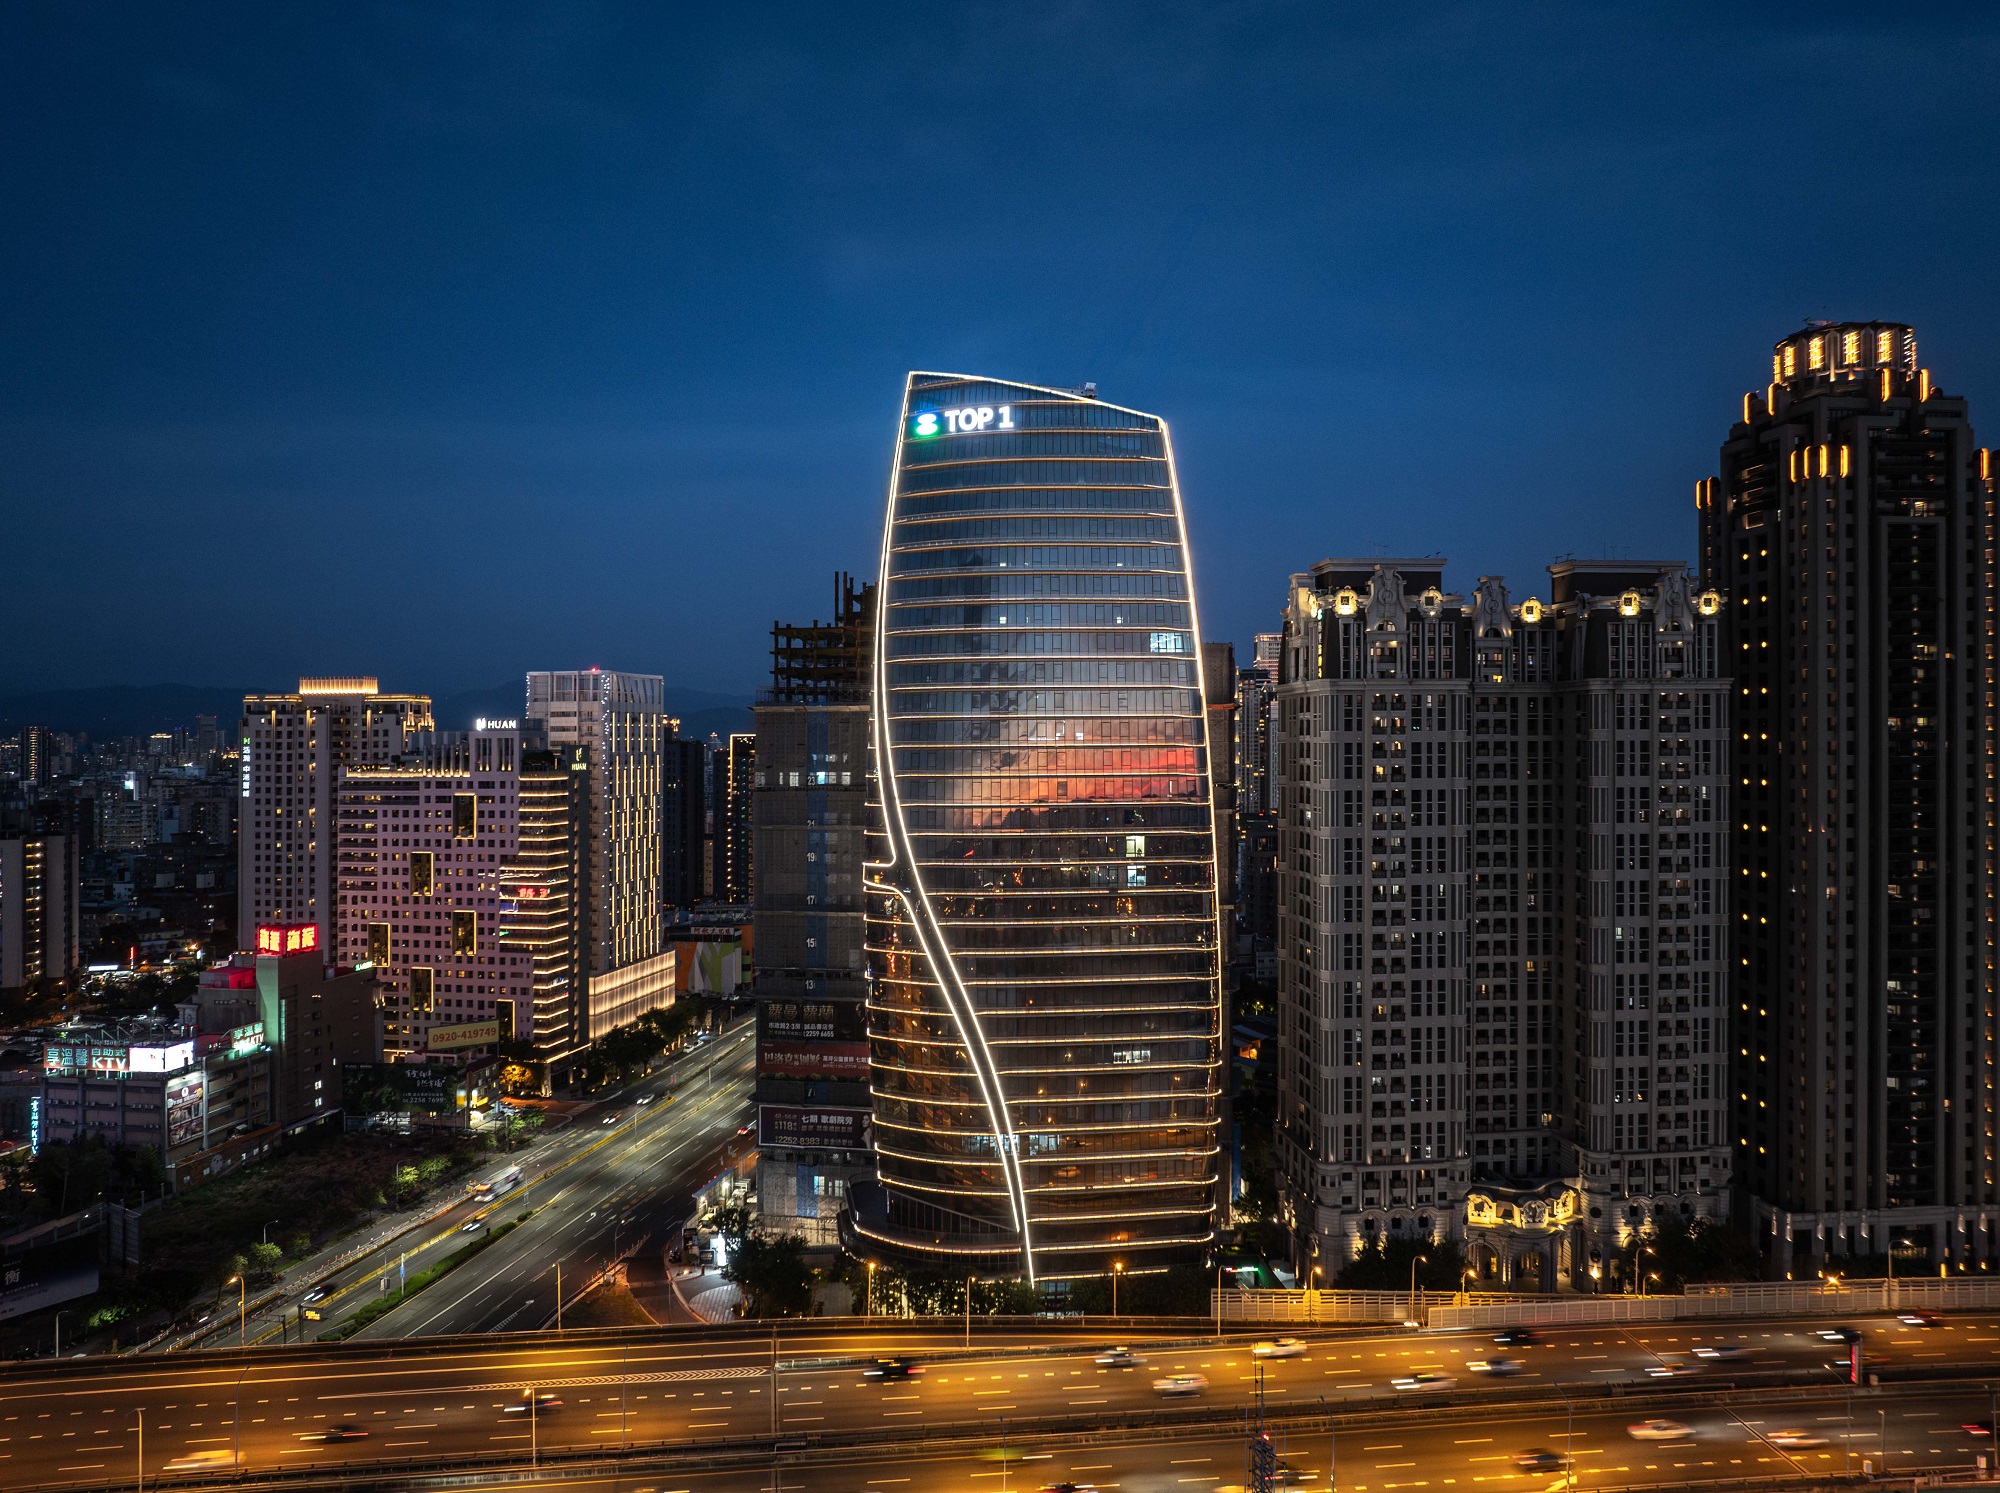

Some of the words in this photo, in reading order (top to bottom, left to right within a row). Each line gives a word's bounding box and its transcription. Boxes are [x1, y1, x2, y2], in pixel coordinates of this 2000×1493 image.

[944, 407, 994, 432] TOP
[998, 405, 1014, 429] 1
[487, 719, 517, 729] HUAN
[571, 762, 587, 771] HUAN
[807, 776, 816, 786] 23
[250, 1033, 265, 1045] KTV
[432, 1027, 497, 1043] 0920-419749
[91, 1048, 127, 1057] 自助式
[92, 1057, 127, 1070] KTV
